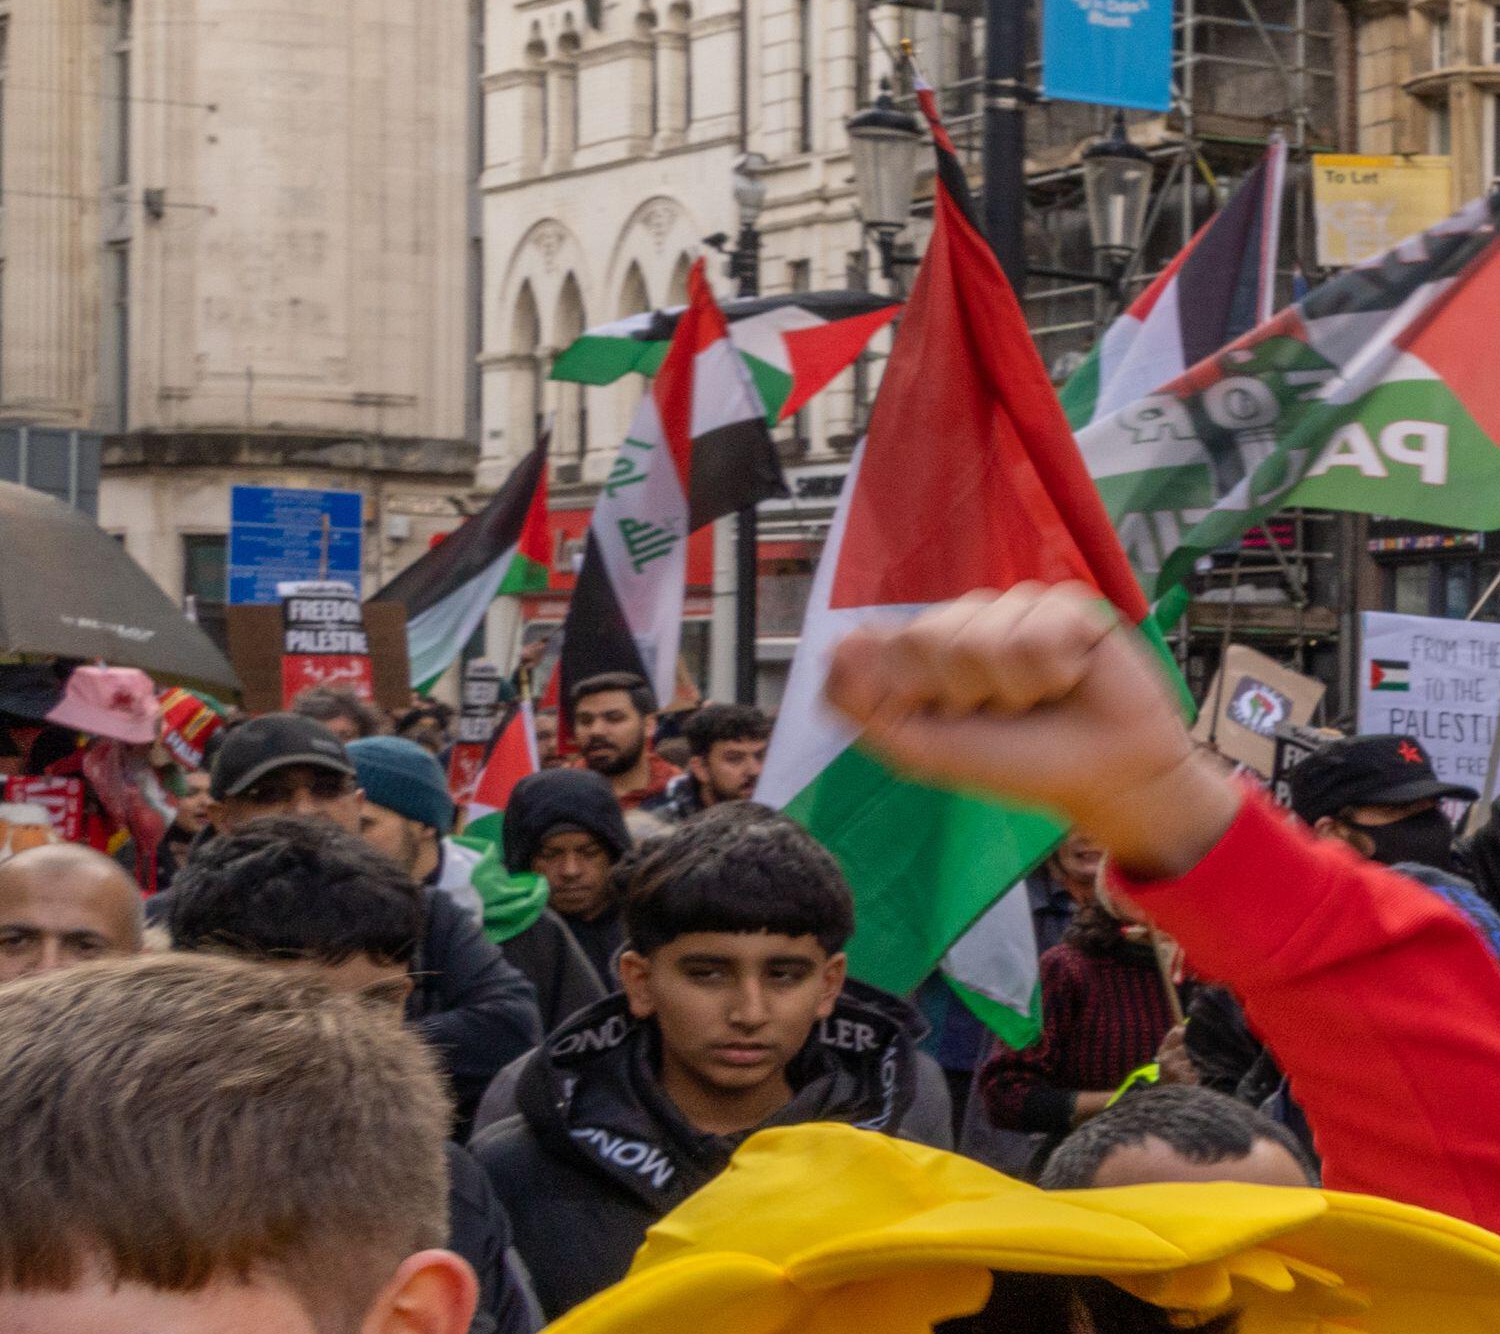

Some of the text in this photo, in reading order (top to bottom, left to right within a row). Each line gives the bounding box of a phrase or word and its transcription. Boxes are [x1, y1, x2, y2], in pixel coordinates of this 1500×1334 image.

[1325, 170, 1378, 184] To Let
[1425, 678, 1444, 700] TO
[1451, 678, 1486, 703] THE
[1456, 757, 1488, 776] FRE
